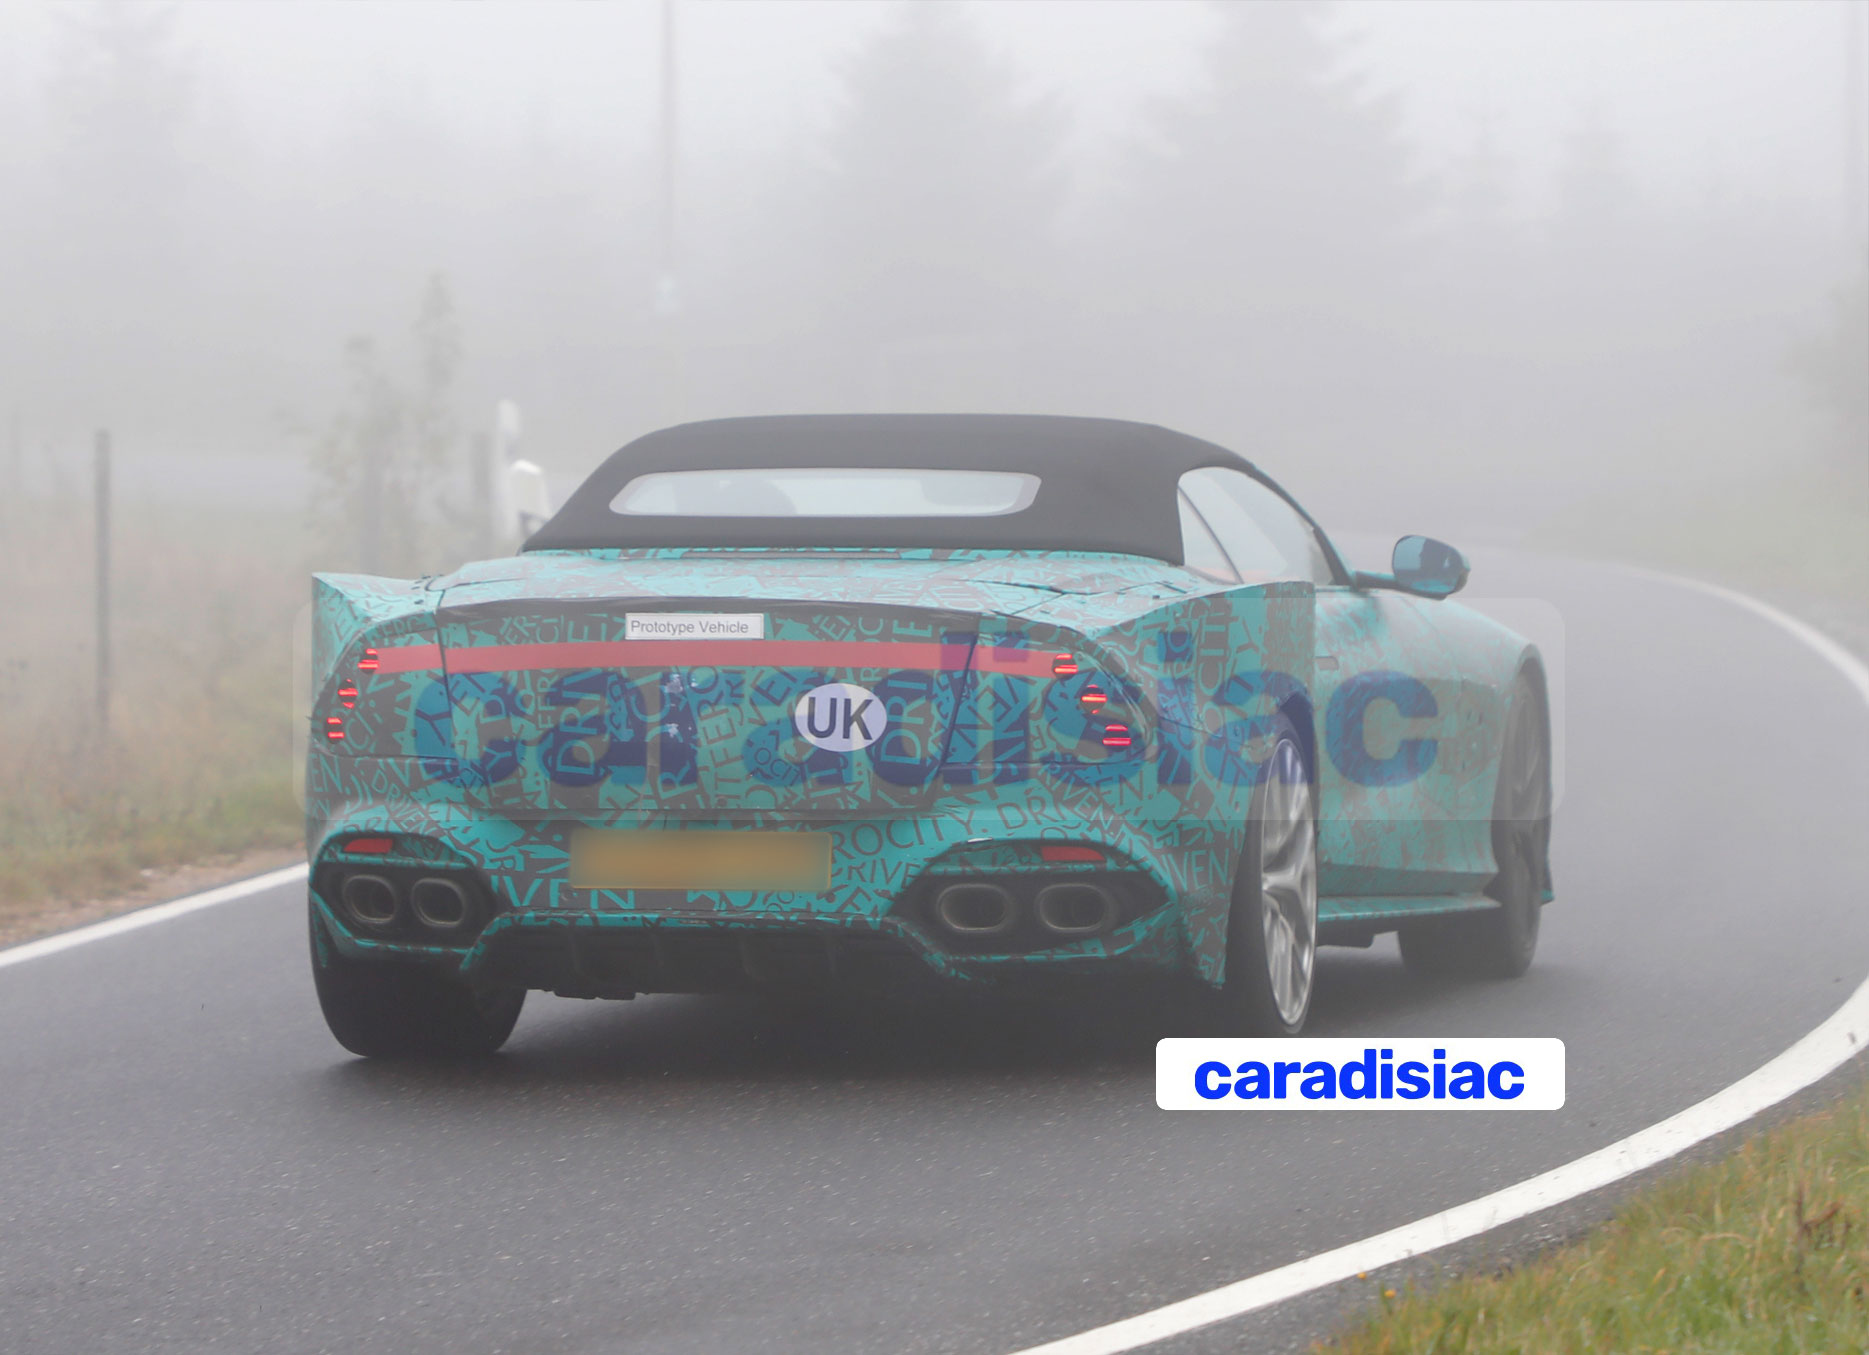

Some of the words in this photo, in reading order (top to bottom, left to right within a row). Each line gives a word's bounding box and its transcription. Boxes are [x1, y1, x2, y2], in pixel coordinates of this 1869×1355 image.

[630, 620, 695, 635] Prototype
[699, 620, 749, 634] Vehicle
[807, 697, 873, 740] UK
